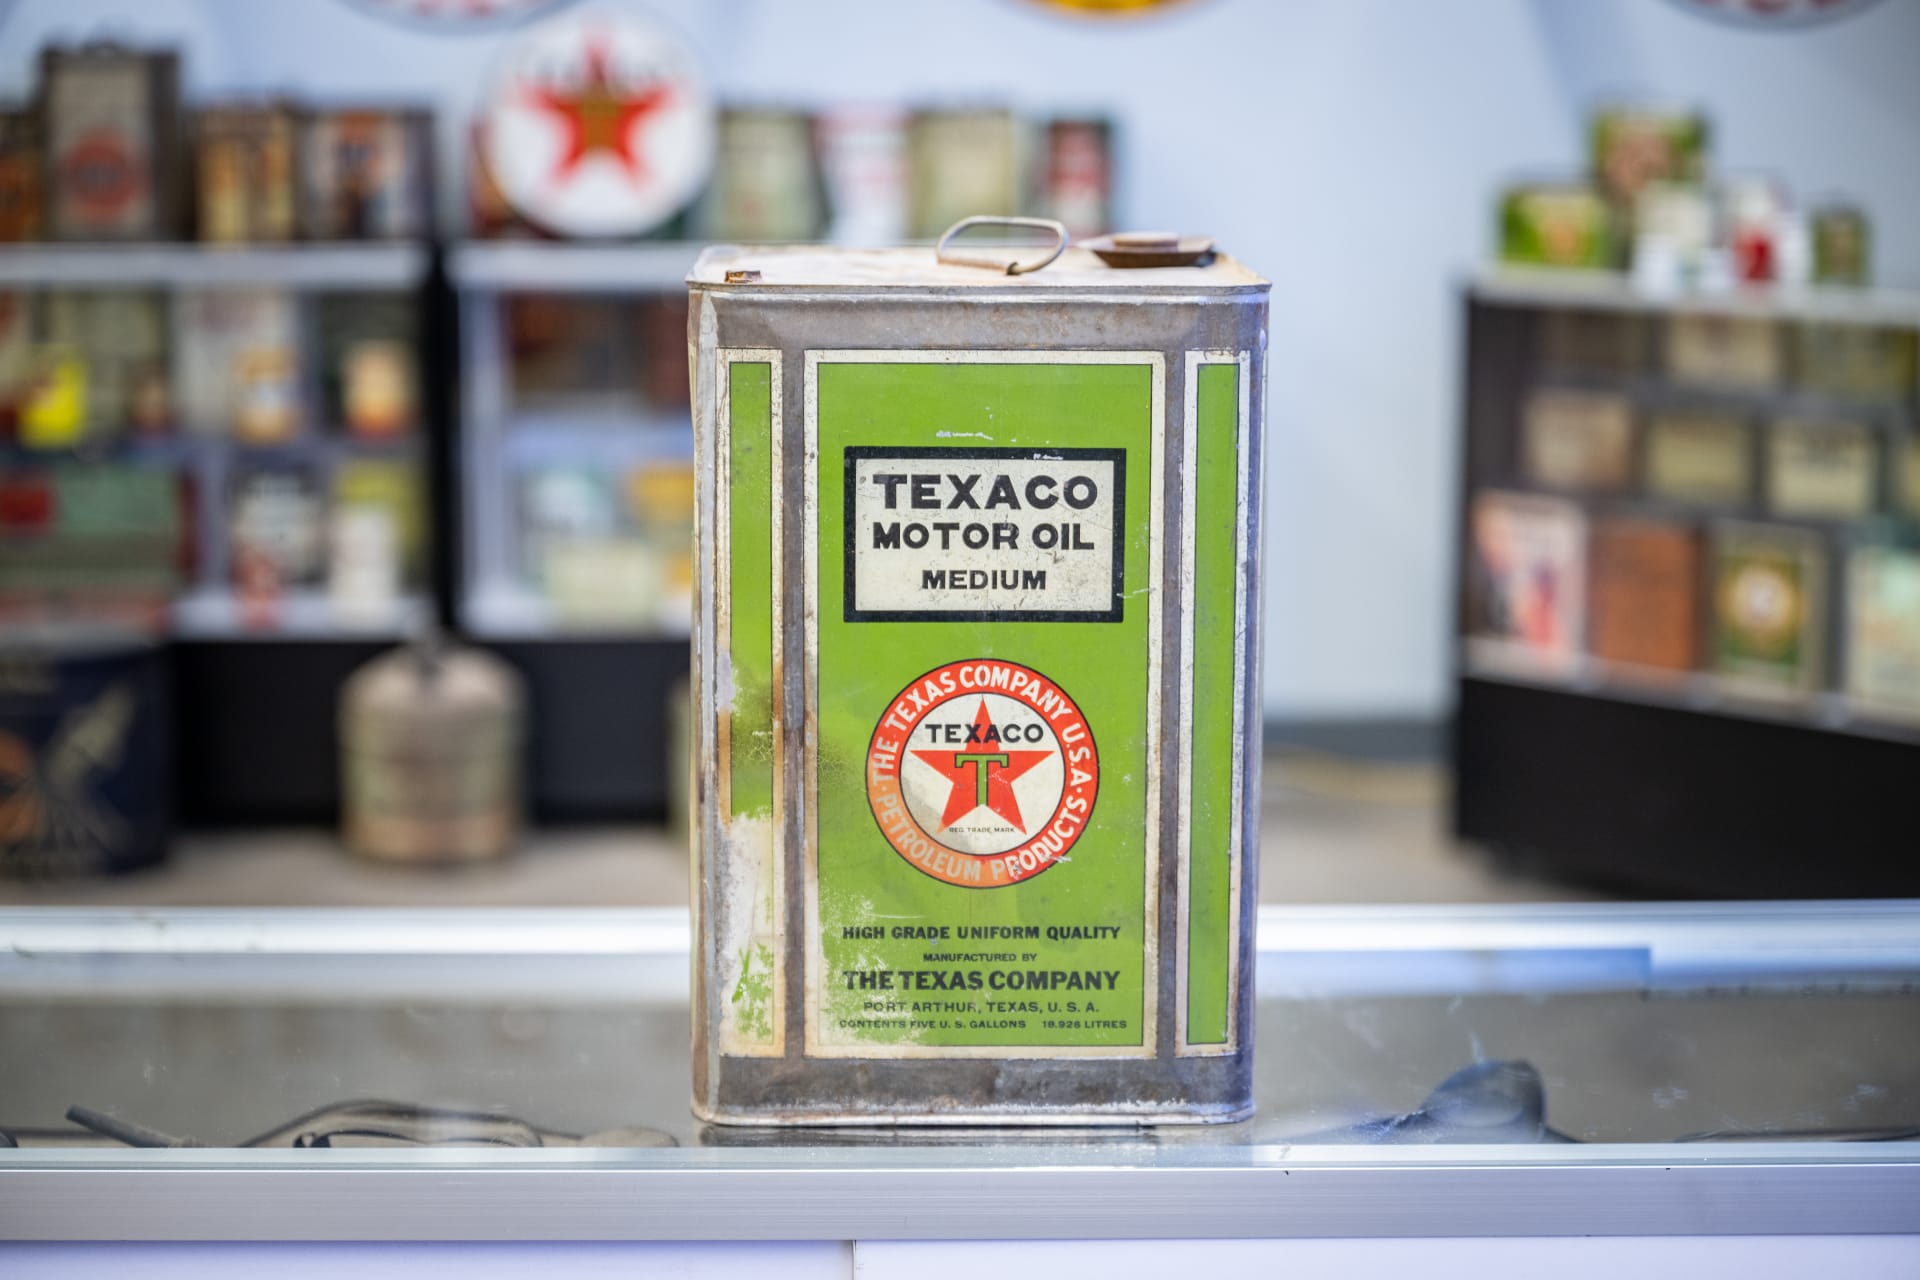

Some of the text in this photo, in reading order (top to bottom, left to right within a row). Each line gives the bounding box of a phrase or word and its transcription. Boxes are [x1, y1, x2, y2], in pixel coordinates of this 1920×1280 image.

[873, 474, 1098, 510] TEXACO
[873, 522, 1094, 550] MOTOR OIL
[922, 570, 1046, 590] MEDIUM
[885, 672, 956, 732] TEXAS
[959, 665, 1072, 720] COMPANY
[925, 723, 1044, 743] TEXACO
[872, 737, 899, 786] THE
[954, 753, 1009, 807] T
[876, 792, 1087, 881] PETROLEUM PRODUCTS
[842, 926, 1120, 940] HIGH GRADE UNIFORM QUALITY
[923, 953, 1037, 962] MANUFACTURED BY
[842, 971, 1120, 990] THE TEXAS COMPANY
[864, 1002, 906, 1013] PORT
[911, 1002, 982, 1014] ARTHUR,
[987, 1002, 1043, 1014] TEXAS,
[839, 1020, 906, 1029] CONTENTS
[910, 1020, 936, 1029] FIVE
[970, 1020, 1026, 1029] GALLONS
[1084, 1020, 1127, 1029] LITRES
